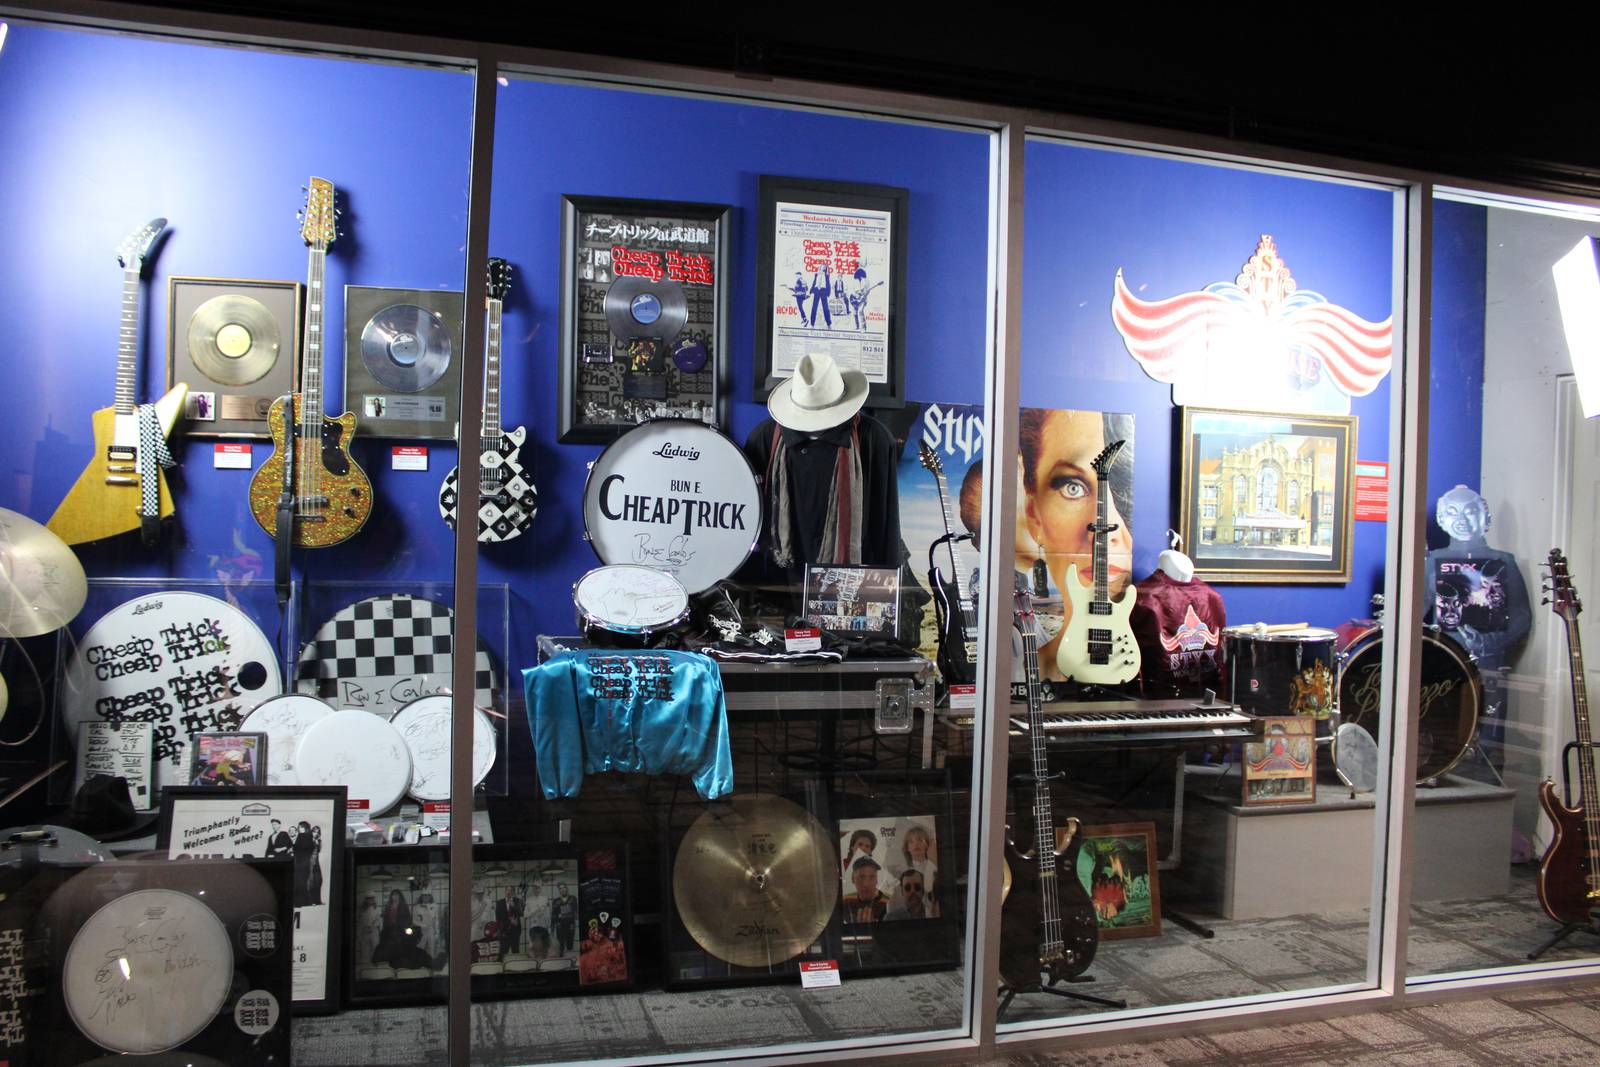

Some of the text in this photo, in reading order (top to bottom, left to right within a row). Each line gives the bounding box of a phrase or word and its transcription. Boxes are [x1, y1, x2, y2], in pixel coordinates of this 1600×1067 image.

[803, 239, 860, 250] Cheap Trick
[805, 247, 861, 257] Cheap Trick
[611, 245, 712, 270] Cheap Trick
[804, 256, 832, 266] Cheap
[613, 260, 715, 285] Cheap Trick
[923, 403, 985, 464] Styx
[652, 442, 701, 461] Ludwig
[670, 479, 691, 493] BUN
[1441, 563, 1477, 573] STYX
[132, 600, 164, 616] Ludwig
[87, 618, 222, 665] Cheap Trick
[95, 636, 231, 681] Cheap Trick
[1170, 649, 1217, 671] STYX
[591, 664, 633, 677] Cheap
[96, 665, 235, 717] Cheap Trick
[591, 675, 672, 691] Cheap Trick
[176, 683, 242, 712] Trick
[594, 687, 634, 704] Cheap
[180, 702, 245, 734] Trick
[183, 816, 240, 838] Triumphantly
[183, 833, 225, 850] Welcomes
[234, 830, 264, 846] where?
